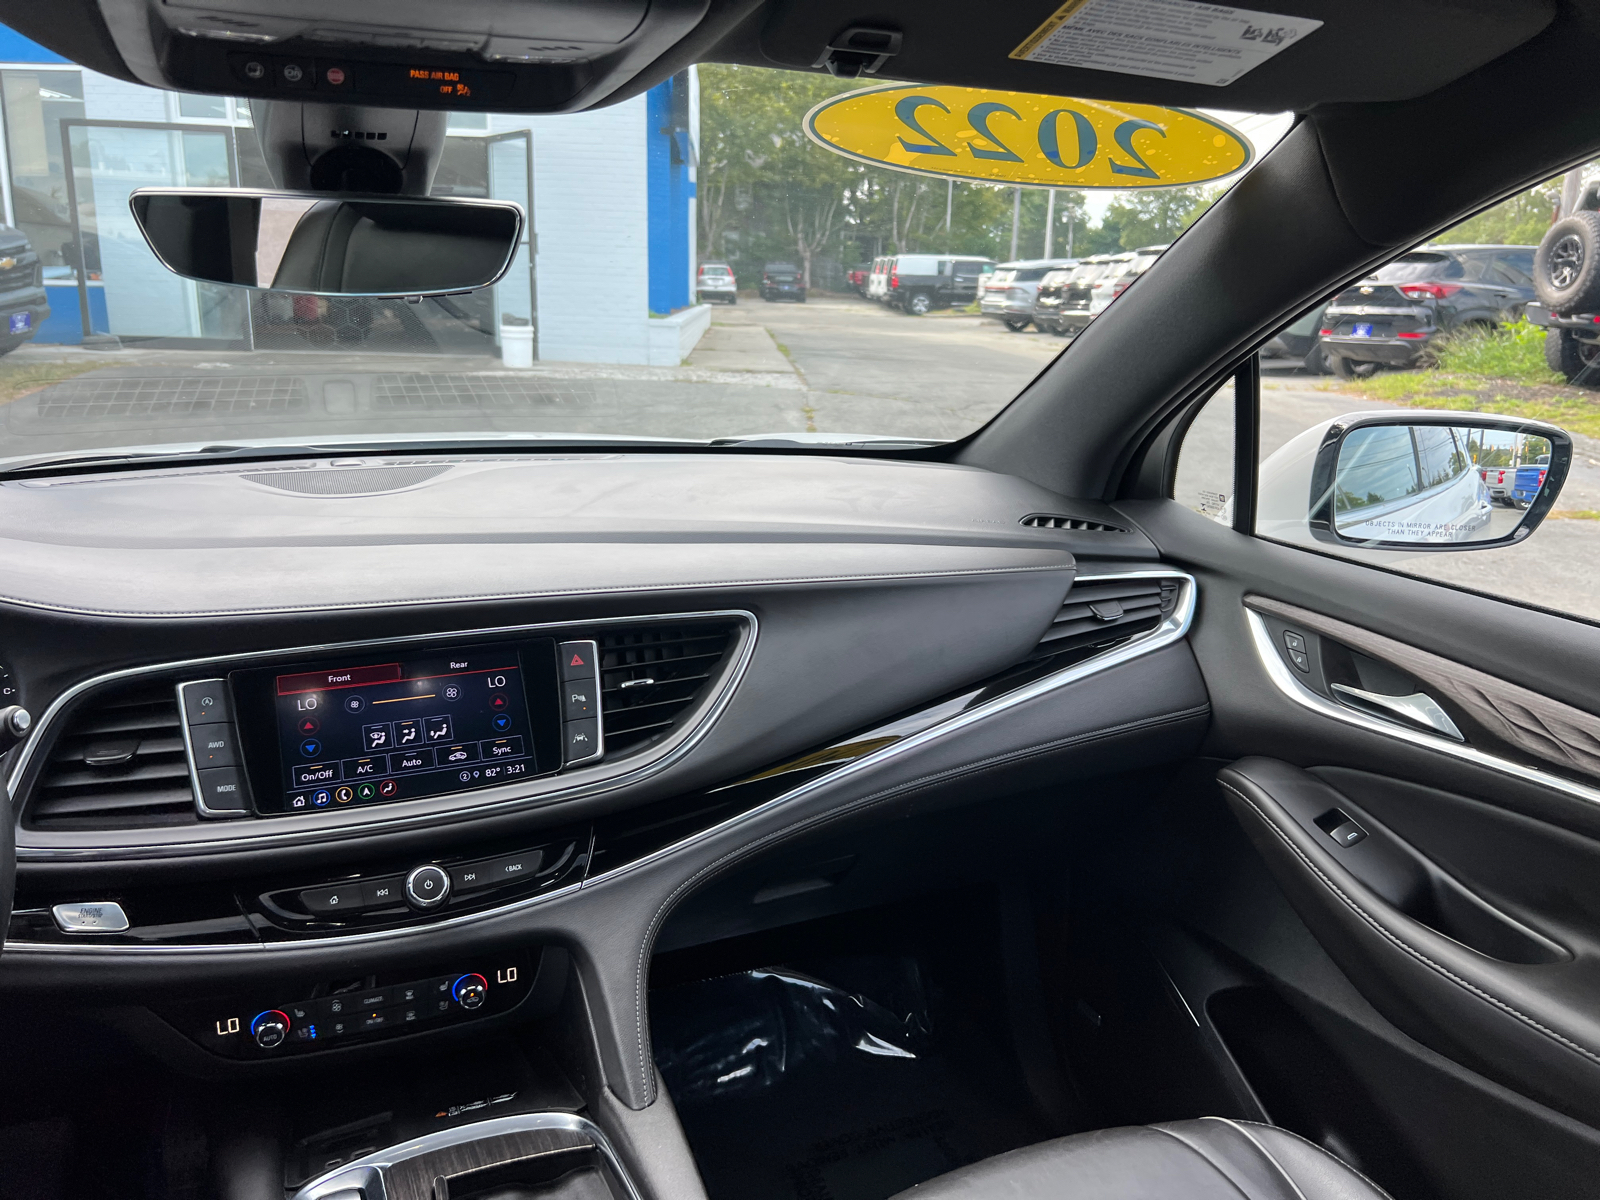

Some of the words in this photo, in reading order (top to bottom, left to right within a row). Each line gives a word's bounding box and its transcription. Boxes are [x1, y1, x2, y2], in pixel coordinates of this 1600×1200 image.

[410, 69, 430, 79] PASS
[431, 71, 443, 80] AIR
[444, 72, 459, 81] BAG
[440, 85, 453, 94] OFF
[1365, 520, 1395, 528] OBJECTS
[1406, 522, 1431, 530] MIRROR
[1450, 524, 1476, 532] CLOSER
[1407, 529, 1425, 537] THEY
[1426, 530, 1453, 538] APPEAR
[450, 661, 468, 669] Rear
[328, 673, 351, 683] Front
[487, 675, 506, 688] LO
[297, 698, 318, 711] LO
[207, 740, 225, 749] AWD
[492, 745, 512, 756] Sync
[401, 759, 422, 768] Auto
[506, 763, 526, 775] 3:21
[356, 764, 374, 775] A/C
[301, 770, 334, 782] On/Off
[216, 784, 237, 793] MODE
[497, 967, 518, 983] LO
[216, 1017, 239, 1035] LO
[263, 1033, 278, 1042] AUTO
